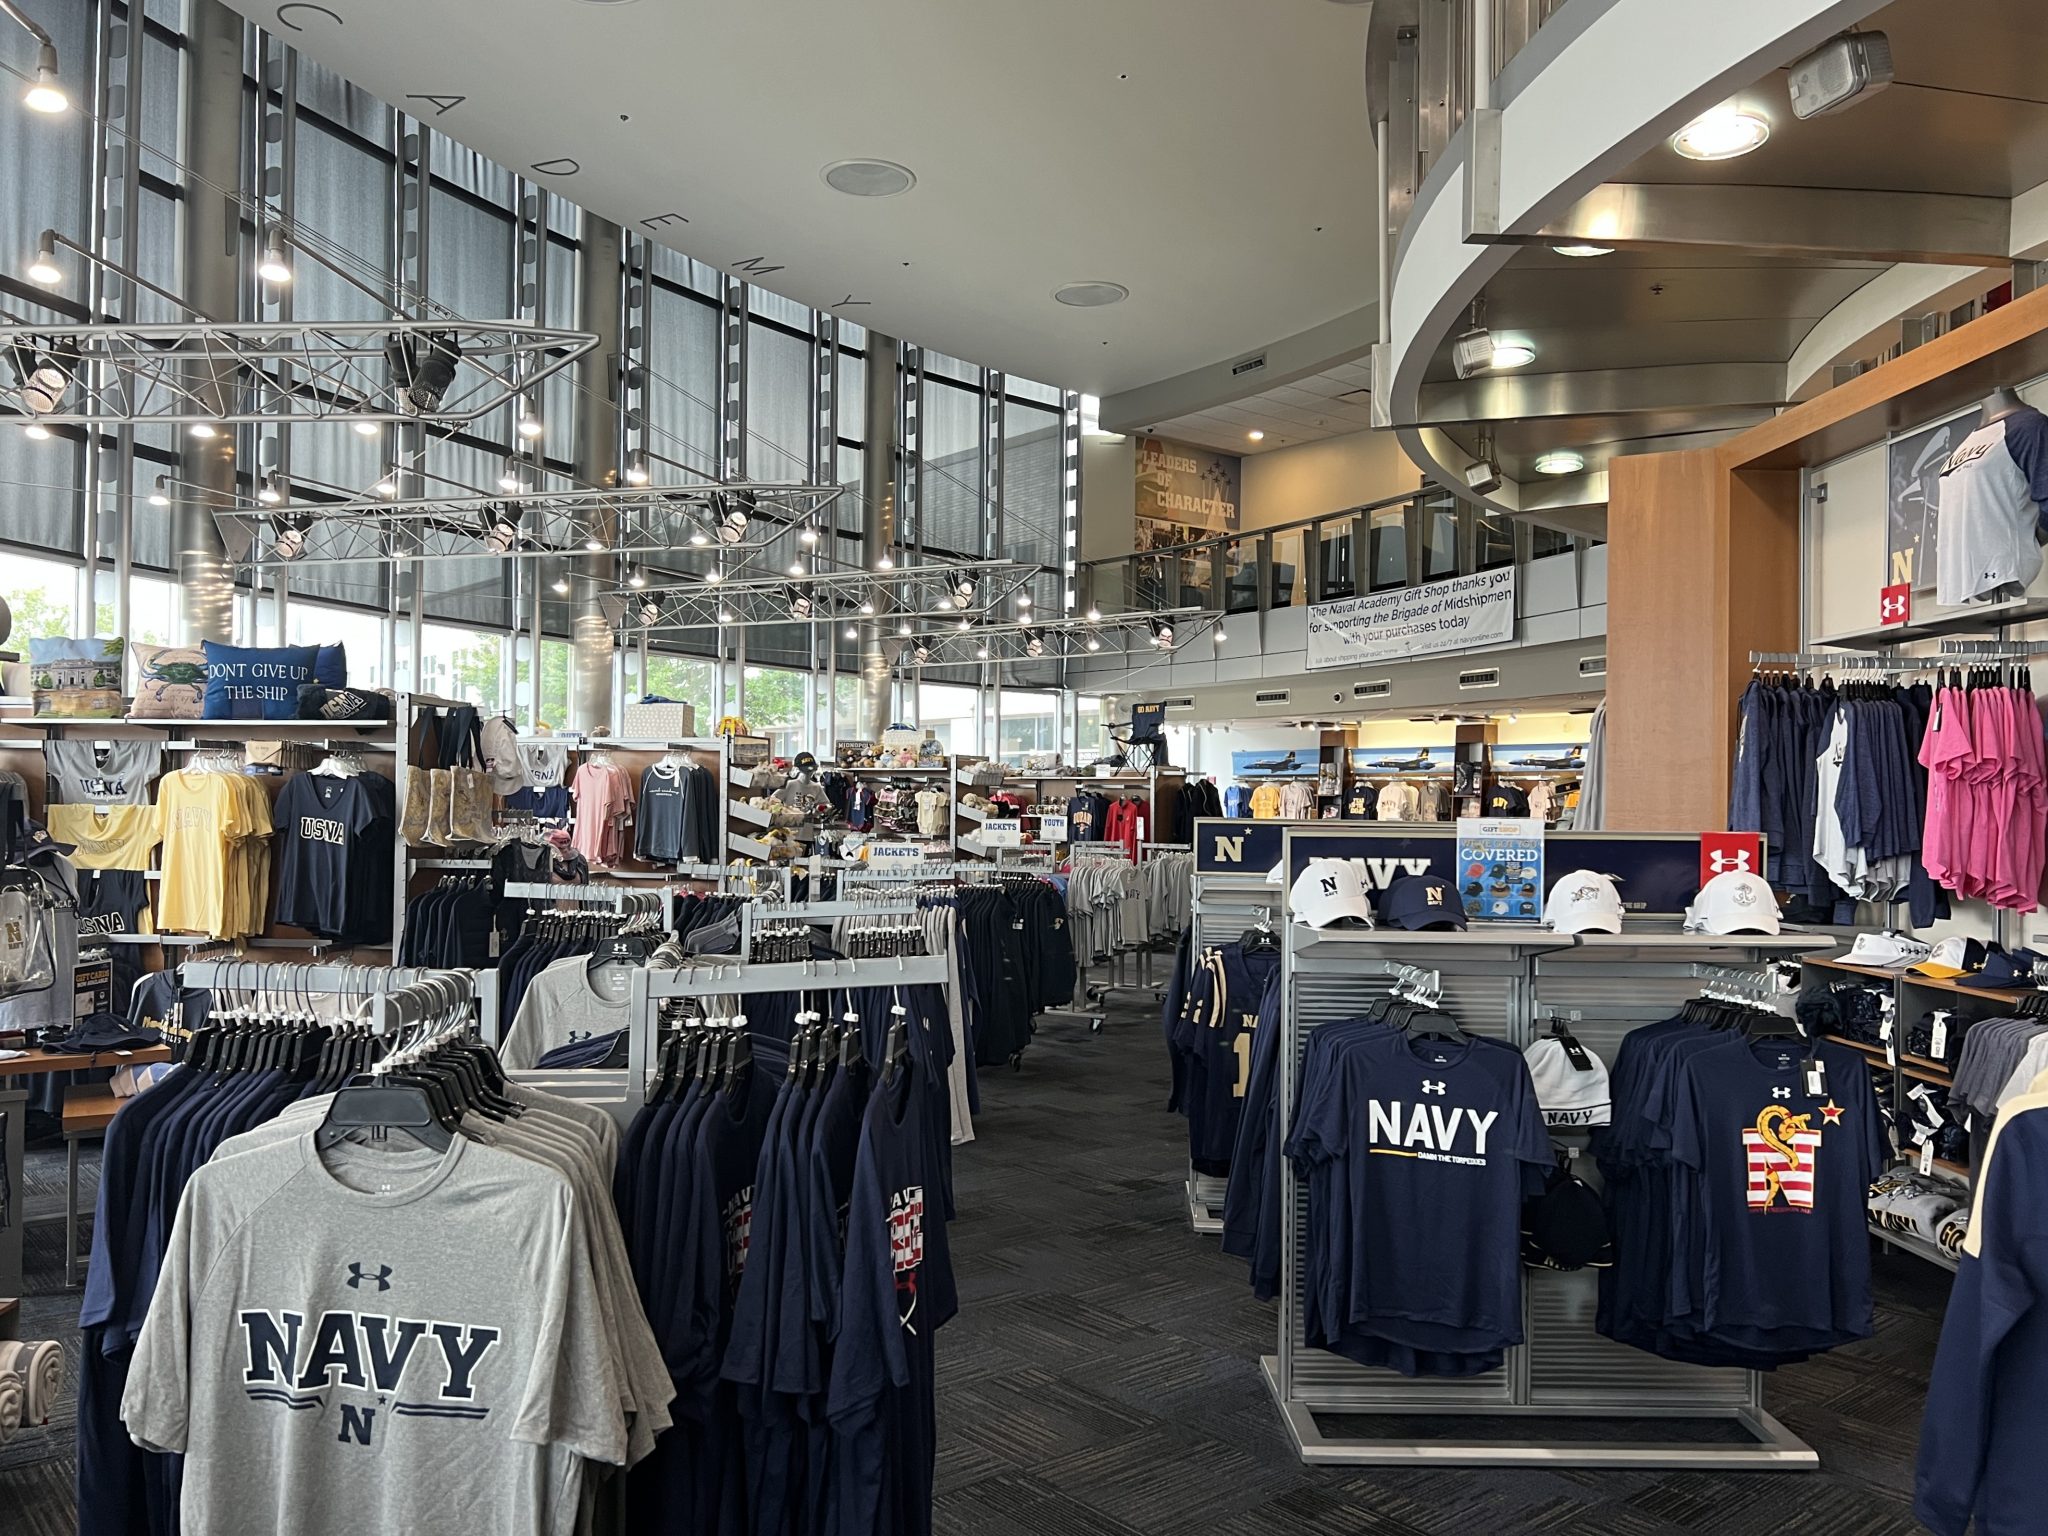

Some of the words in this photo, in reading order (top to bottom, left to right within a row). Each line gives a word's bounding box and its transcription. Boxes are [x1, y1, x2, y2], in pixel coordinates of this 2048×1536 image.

[1143, 450, 1197, 474] LEADERS
[1939, 442, 1994, 477] Navy
[1157, 470, 1173, 488] OF
[1156, 491, 1235, 519] CHARACTER
[1892, 547, 1914, 585] N
[1311, 606, 1328, 618] The
[1329, 603, 1356, 615] Naval
[1358, 593, 1403, 611] Academy
[1404, 588, 1422, 603] Gift
[1424, 584, 1450, 599] Shop
[1452, 576, 1486, 593] thanks
[1489, 571, 1511, 588] you
[1309, 622, 1323, 634] for
[1373, 610, 1390, 624] the
[1391, 603, 1429, 622] Brigade
[1431, 601, 1443, 614] of
[1444, 589, 1513, 612] Midshipmen
[1342, 632, 1361, 645] with
[1363, 630, 1384, 646] your
[1385, 620, 1437, 642] purchases
[1439, 614, 1470, 632] today
[1324, 654, 1337, 664] about
[1338, 652, 1358, 662] shipping
[1358, 651, 1370, 661] your
[1460, 631, 1504, 644] navyonline.com
[209, 663, 247, 681] DONT
[252, 663, 287, 679] GIVE
[290, 665, 309, 681] UP
[224, 685, 254, 700] THE
[256, 686, 288, 701] SHIP
[320, 691, 365, 720] USNA
[1137, 705, 1145, 713] GO
[1145, 704, 1161, 713] NAVY
[173, 806, 212, 833] NAVY
[300, 816, 345, 846] USNA
[985, 822, 1017, 831] JACKETS
[1044, 818, 1065, 827] YOUTH
[873, 847, 920, 857] JACKETS
[1214, 836, 1244, 862] N
[1461, 849, 1538, 862] COVERED
[1321, 877, 1338, 892] N
[1426, 887, 1443, 901] N
[5, 921, 22, 943] N
[75, 973, 91, 983] GIFT
[90, 969, 110, 980] CARDS
[1368, 1099, 1498, 1154] NAVY
[1547, 1109, 1593, 1125] NAVY
[1417, 1151, 1437, 1161] DAMN
[1437, 1154, 1452, 1163] THE
[238, 1309, 502, 1402] NAVY
[338, 1404, 376, 1446] N
